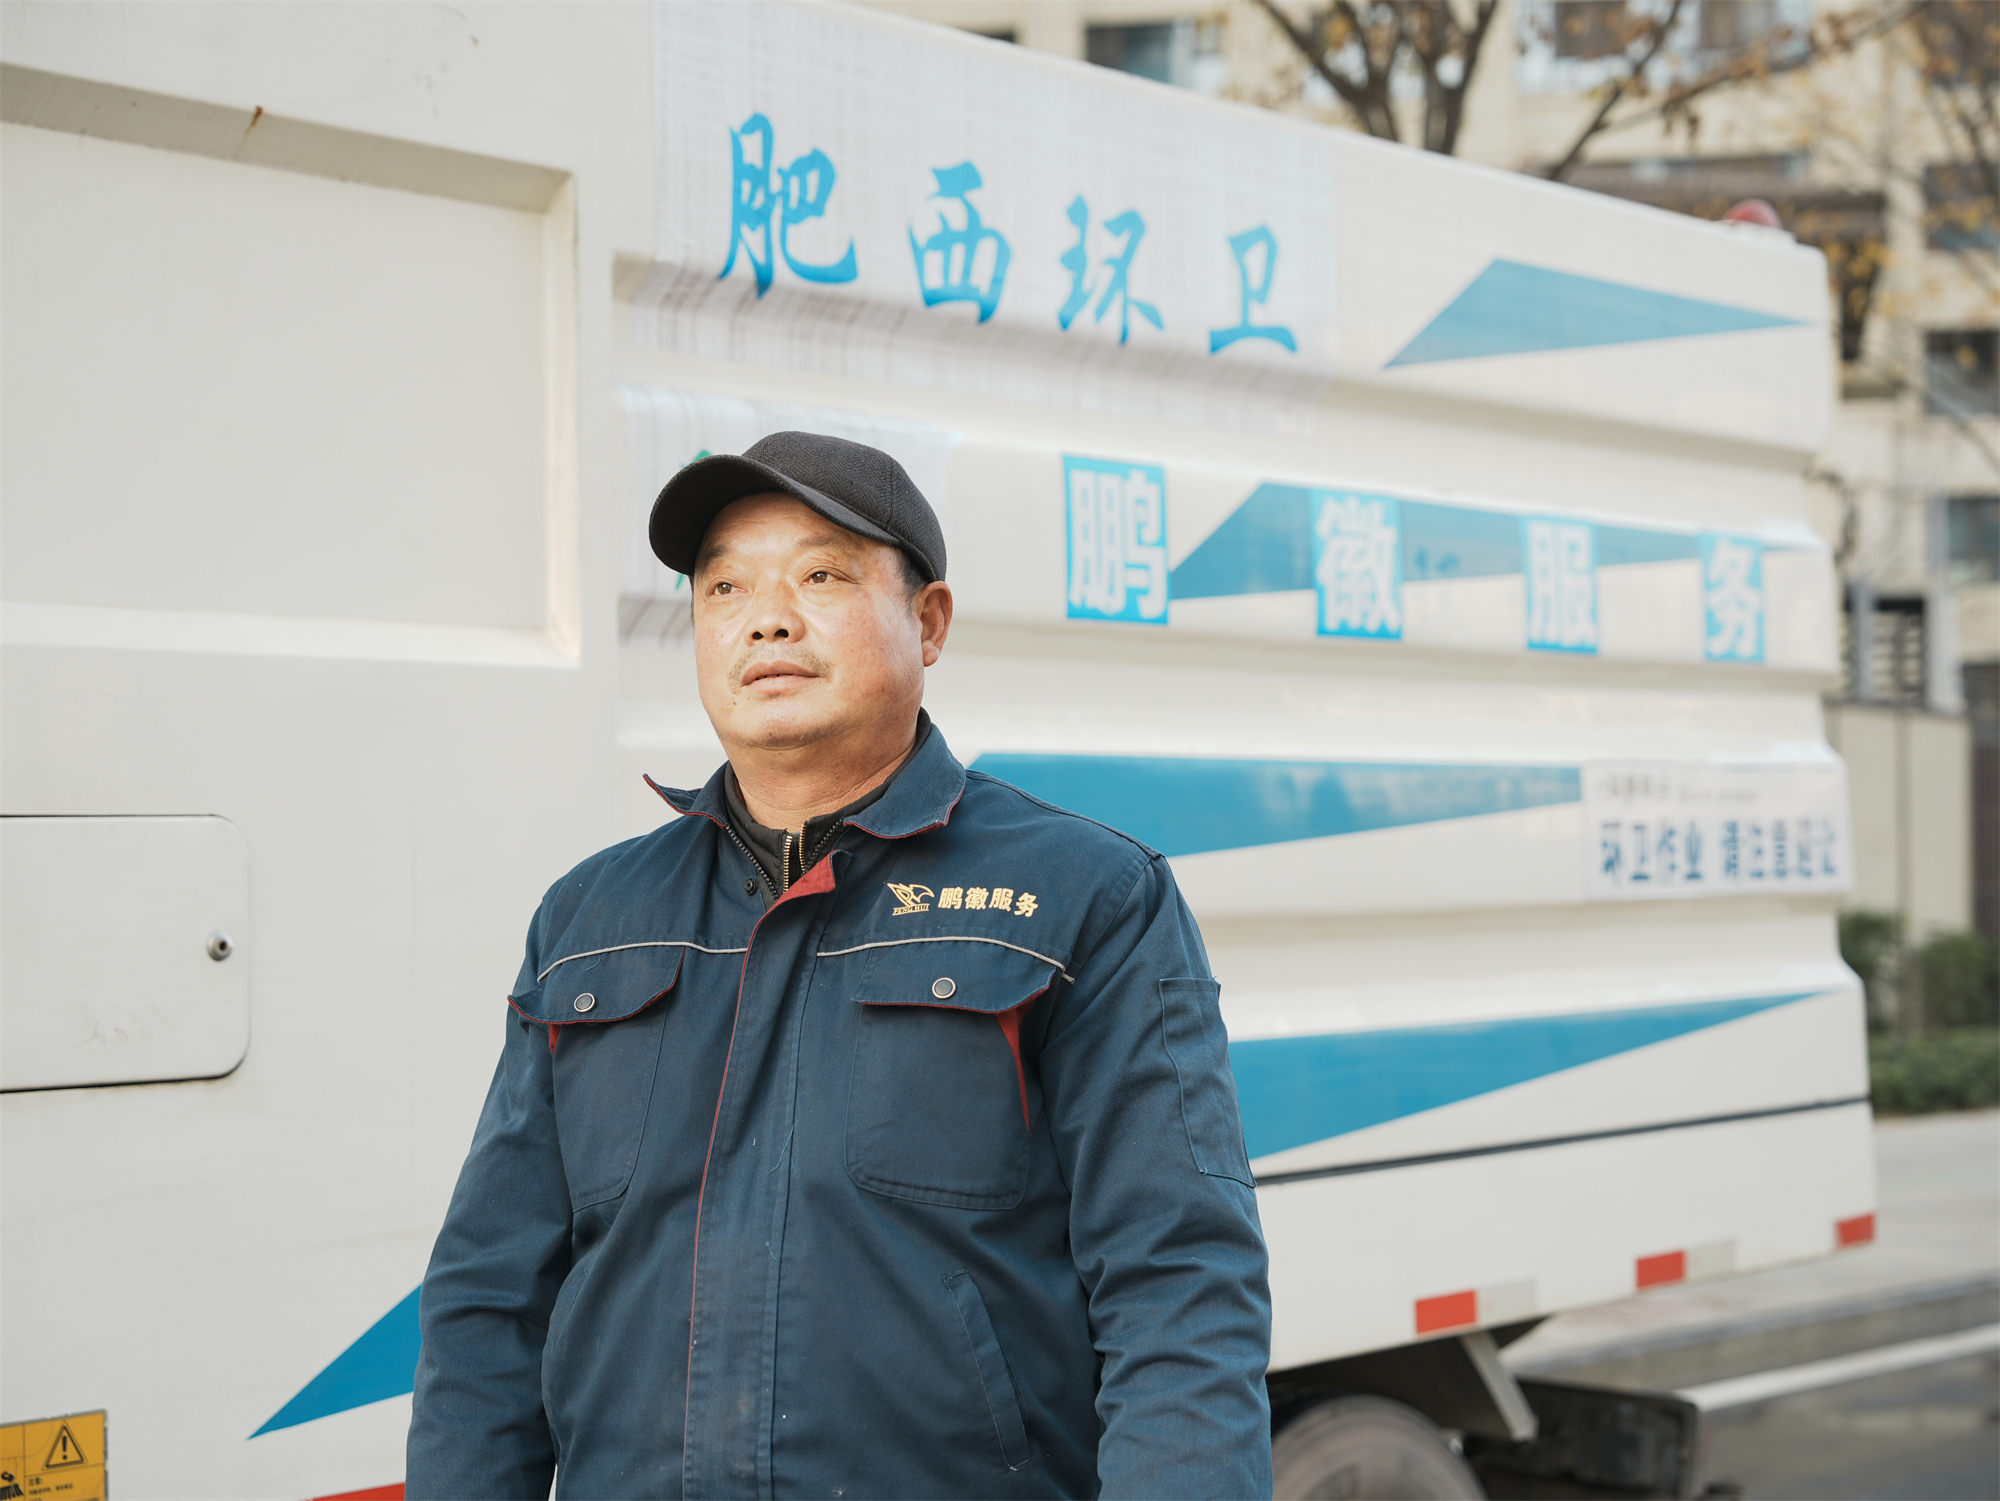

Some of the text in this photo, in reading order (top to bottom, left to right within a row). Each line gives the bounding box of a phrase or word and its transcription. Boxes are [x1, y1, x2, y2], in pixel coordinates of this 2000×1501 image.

[718, 112, 1298, 355] 肥西环卫
[1067, 467, 1763, 658] 鹏徽服务
[938, 886, 1039, 918] 鹏徽服务
